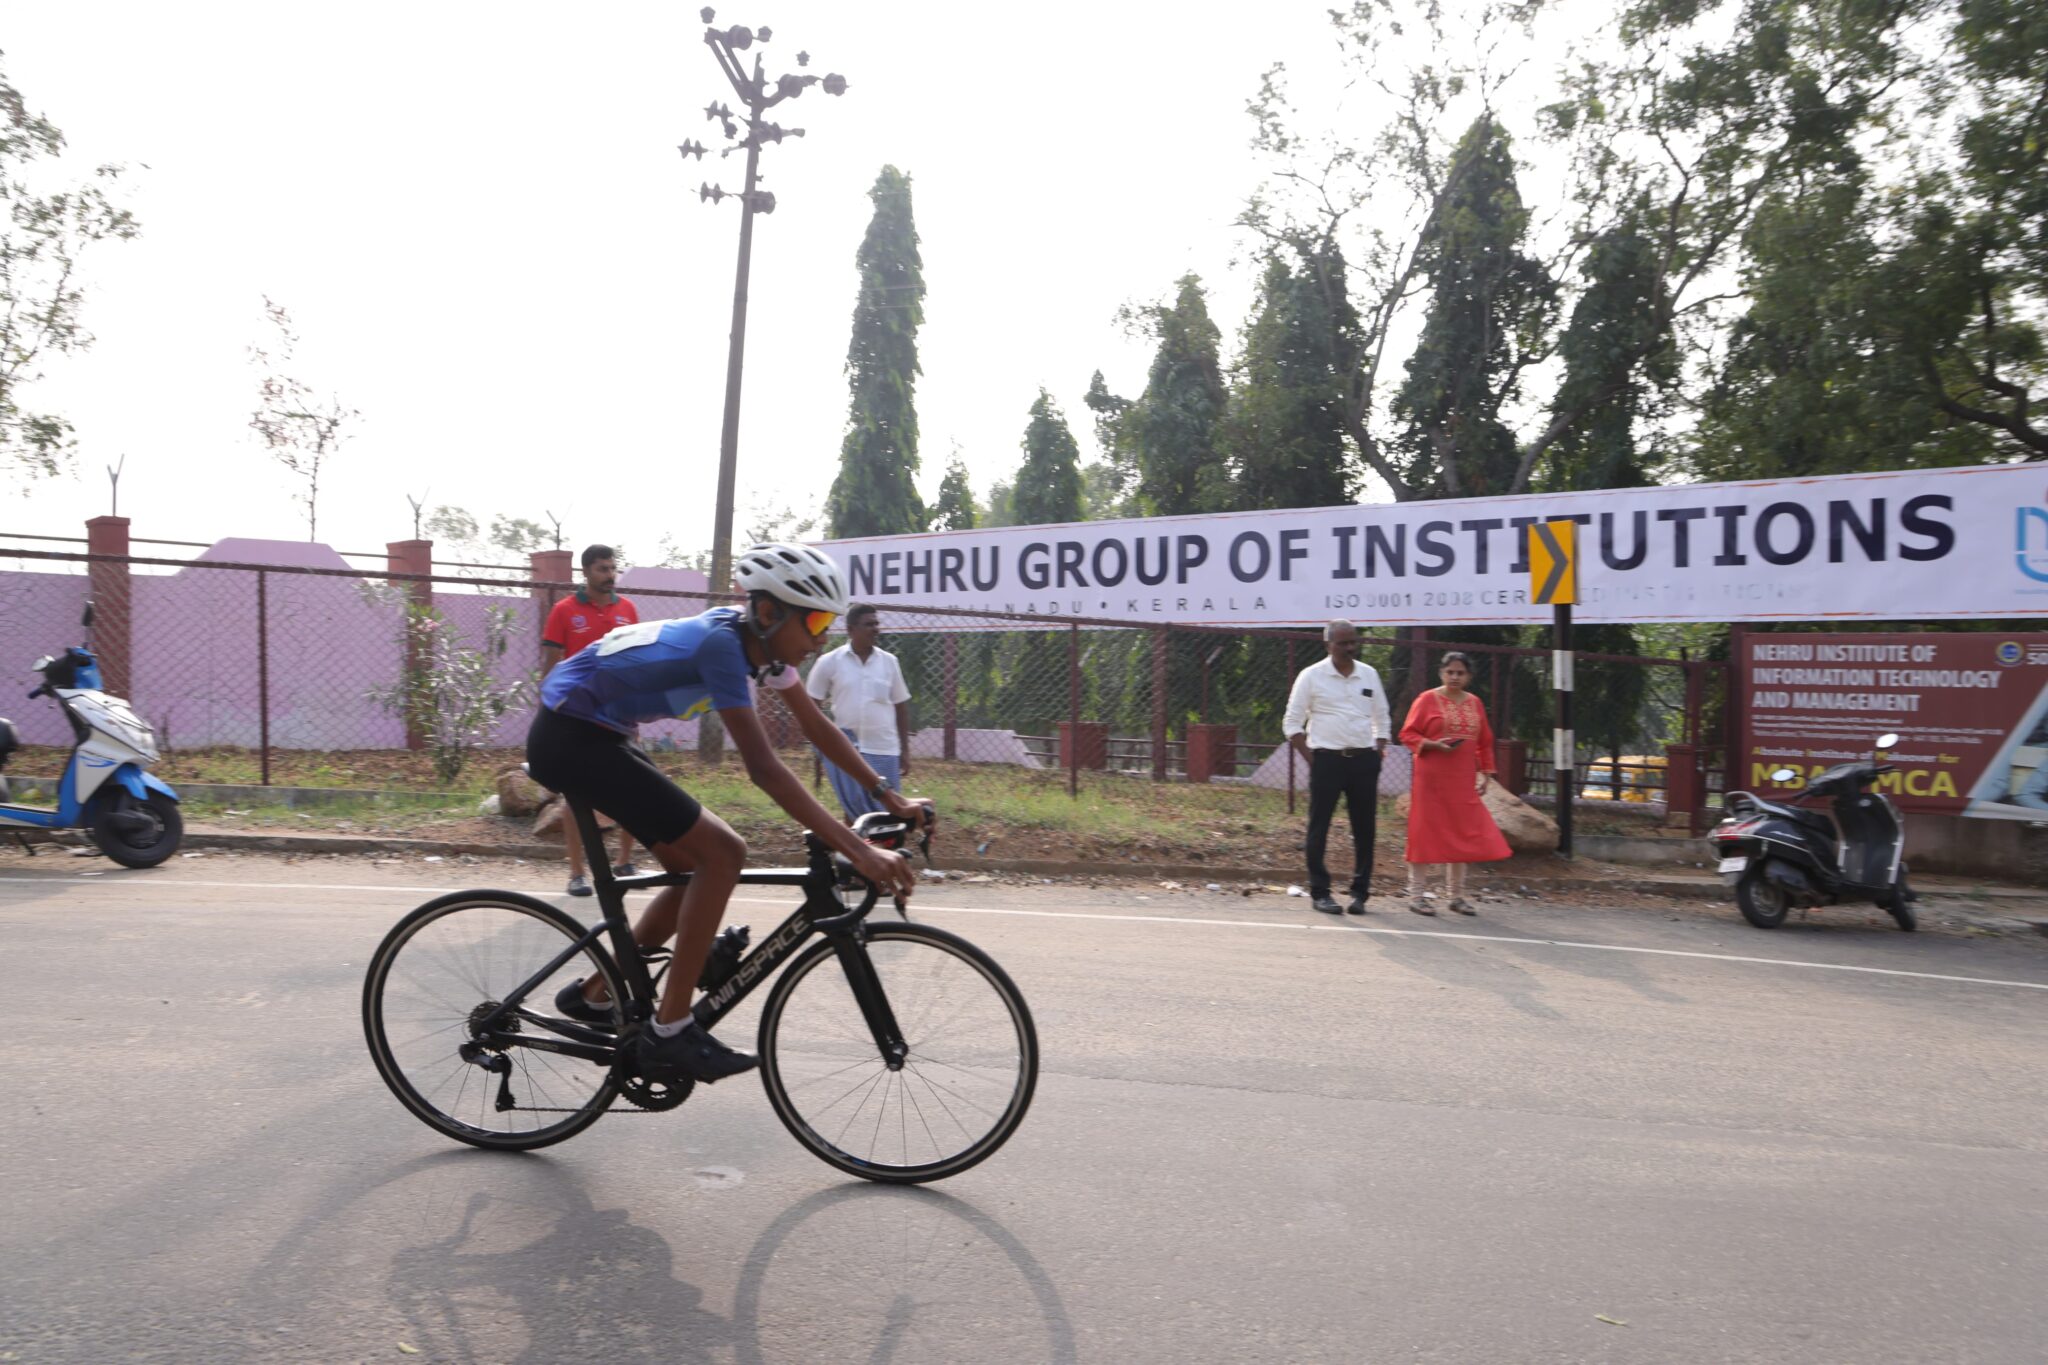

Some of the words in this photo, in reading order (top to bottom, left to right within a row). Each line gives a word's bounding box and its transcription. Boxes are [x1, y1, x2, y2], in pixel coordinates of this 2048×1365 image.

[849, 545, 1000, 597] NEHRU
[1018, 534, 1209, 591] GROUP
[1229, 528, 1309, 584] OF
[1332, 493, 1956, 580] INSTIUTIONS
[1127, 596, 1268, 612] KERALA
[1324, 593, 1361, 609] ISO
[1752, 644, 1813, 662] NEHRU
[1816, 644, 1909, 663] INSTITUTE
[1911, 645, 1937, 663] OF
[1752, 667, 1876, 687] INFORMATION
[1878, 668, 2003, 689] TECHNOLOGY
[1752, 691, 1791, 709] AND
[1792, 691, 1921, 712] MANAGEMENT
[1870, 769, 1959, 798] MCA
[708, 913, 810, 1011] WINSPACE
